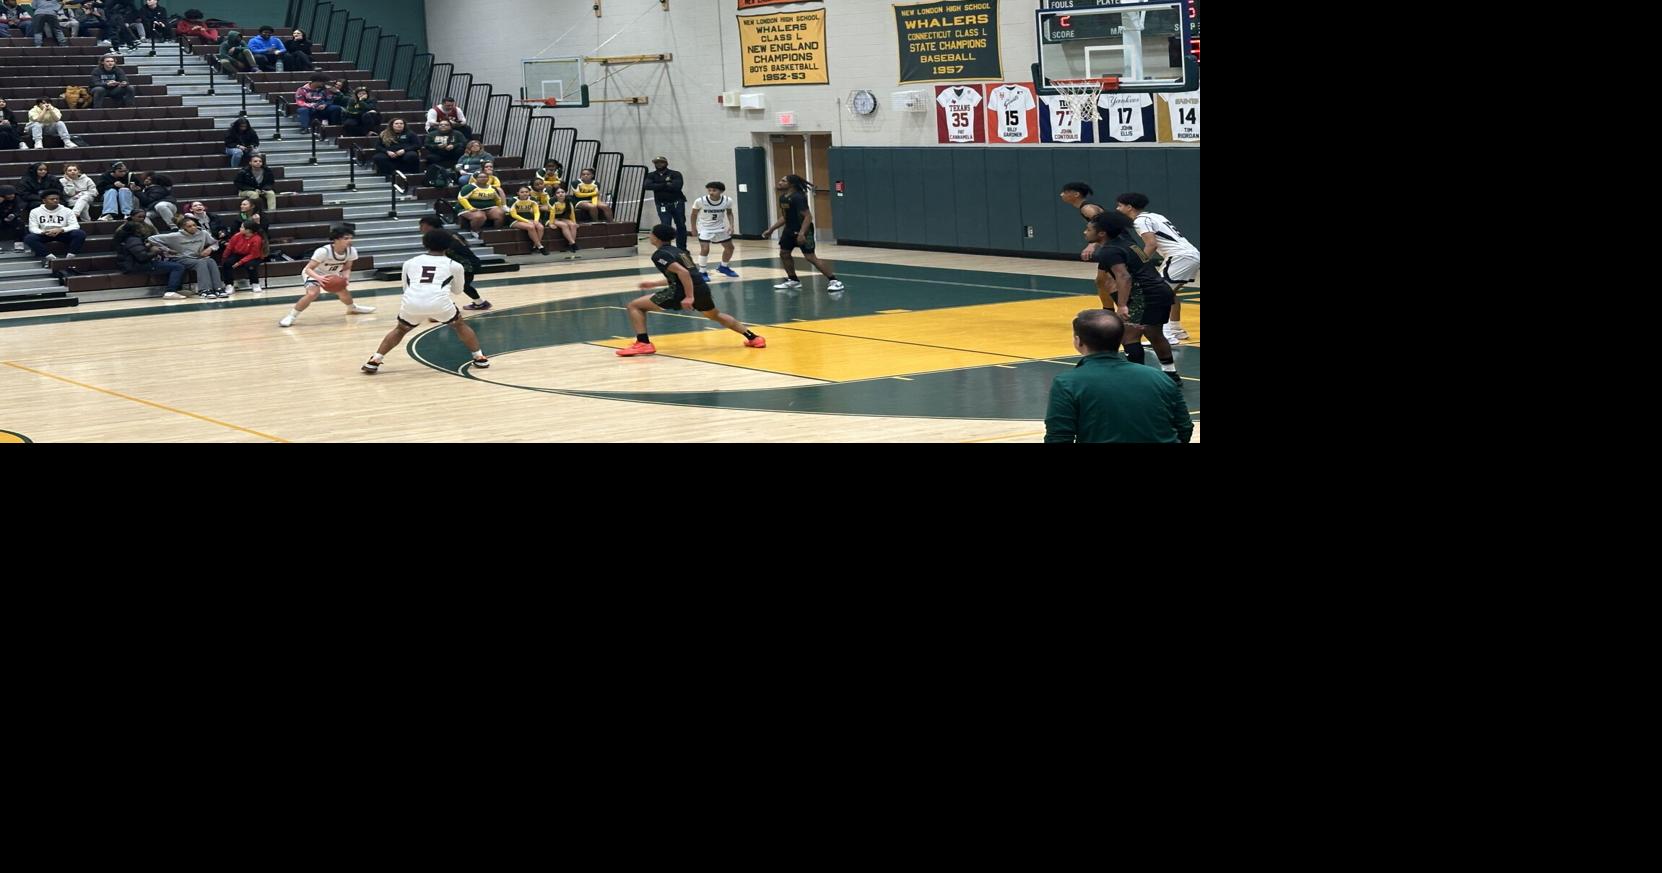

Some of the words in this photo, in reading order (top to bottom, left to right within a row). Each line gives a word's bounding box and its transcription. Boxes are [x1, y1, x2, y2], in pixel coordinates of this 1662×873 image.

[917, 6, 943, 14] LONDON
[904, 14, 988, 29] WHALERS
[756, 24, 807, 34] WHALERS
[908, 30, 951, 40] CONNECTICUT
[955, 28, 978, 38] CLASS
[1052, 30, 1075, 38] SCORE
[760, 34, 792, 42] CLASS
[748, 45, 766, 54] NEW
[770, 42, 818, 52] ENGLAND
[910, 42, 936, 52] STATE
[940, 38, 986, 50] CHAMPIONS
[754, 52, 813, 64] CHAMPIONS
[920, 52, 976, 63] BASEBALL
[771, 63, 820, 71] BASKETBALL
[932, 66, 964, 74] 1957
[763, 72, 806, 81] 1952-53
[1109, 95, 1140, 108] Yankees
[952, 112, 969, 127] 35
[1005, 110, 1019, 126] 15
[1056, 110, 1073, 126] 77
[1118, 108, 1132, 124] 17
[1178, 108, 1196, 124] 14
[39, 214, 64, 224] GAP
[420, 266, 436, 284] 5
